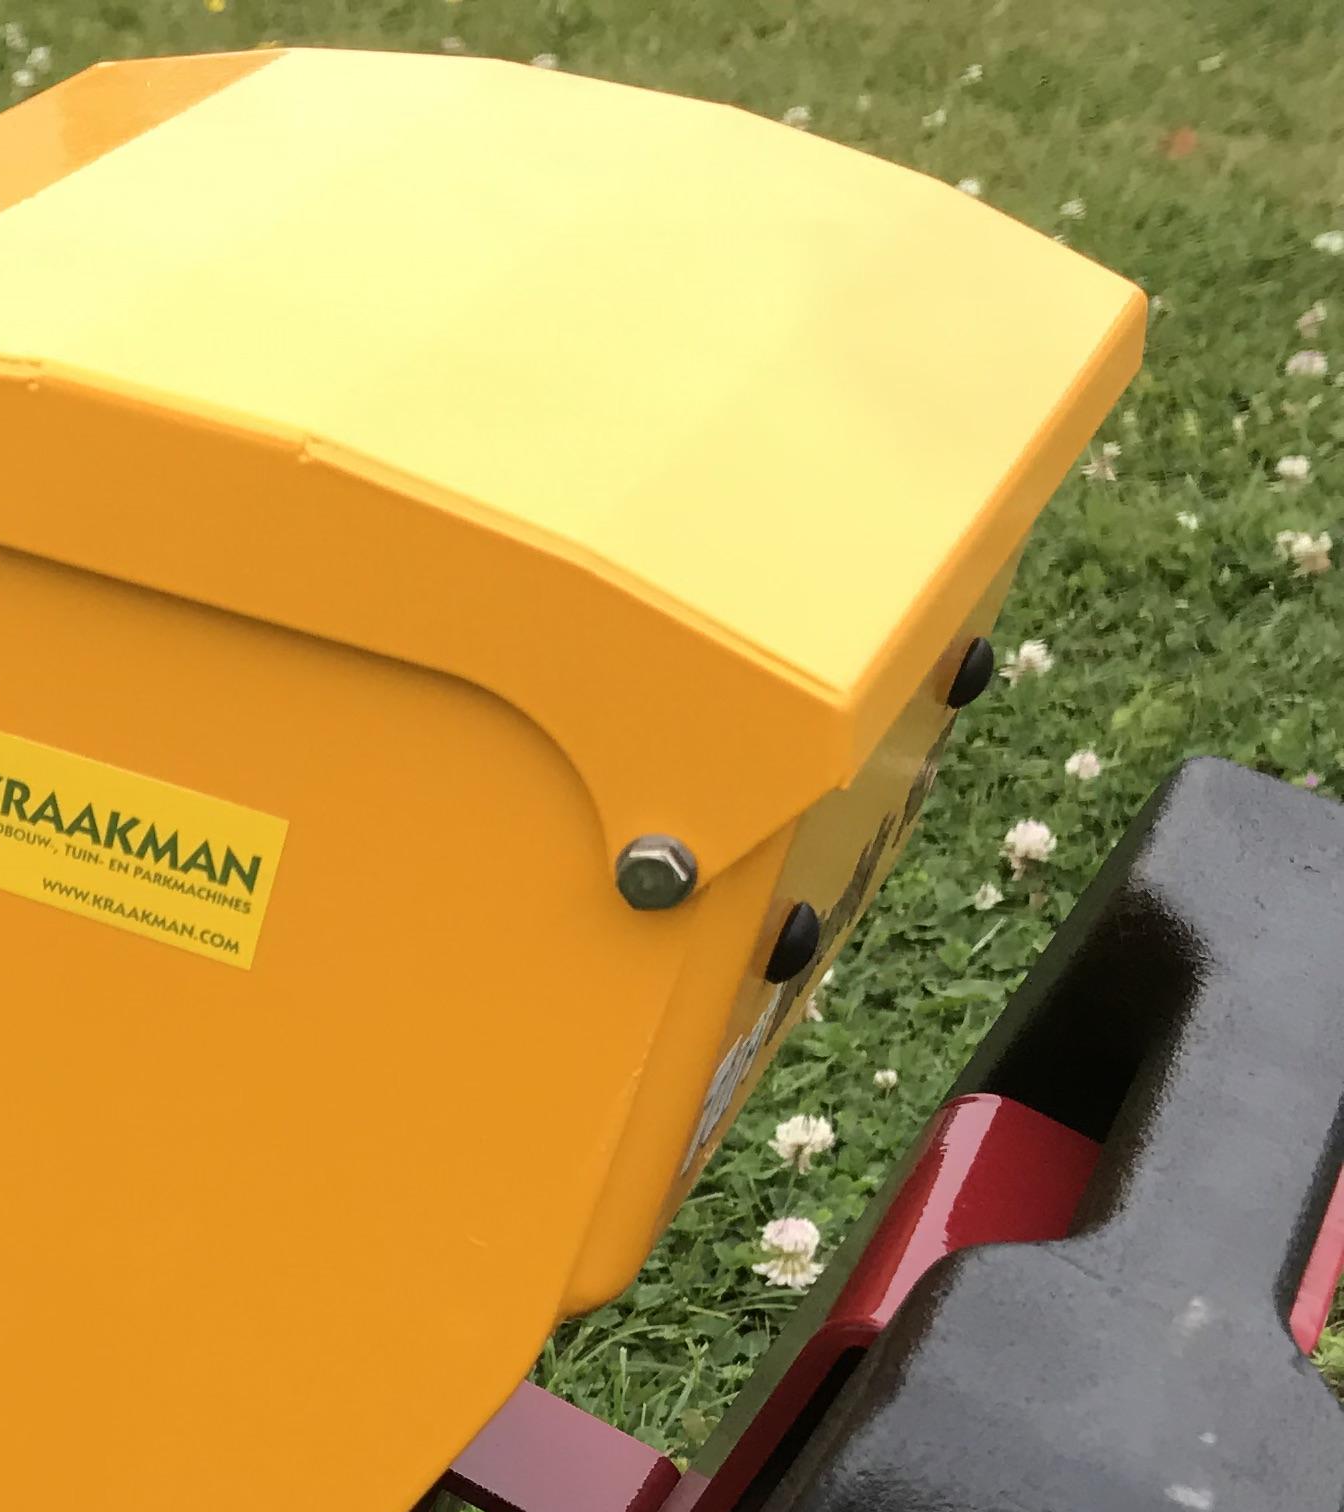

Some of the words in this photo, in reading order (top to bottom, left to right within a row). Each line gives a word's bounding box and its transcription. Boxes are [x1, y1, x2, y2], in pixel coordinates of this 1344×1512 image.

[42, 878, 240, 954] WWW.KRAAKMAN.COM
[109, 858, 129, 875] EN
[134, 867, 252, 914] PARKMACHINES
